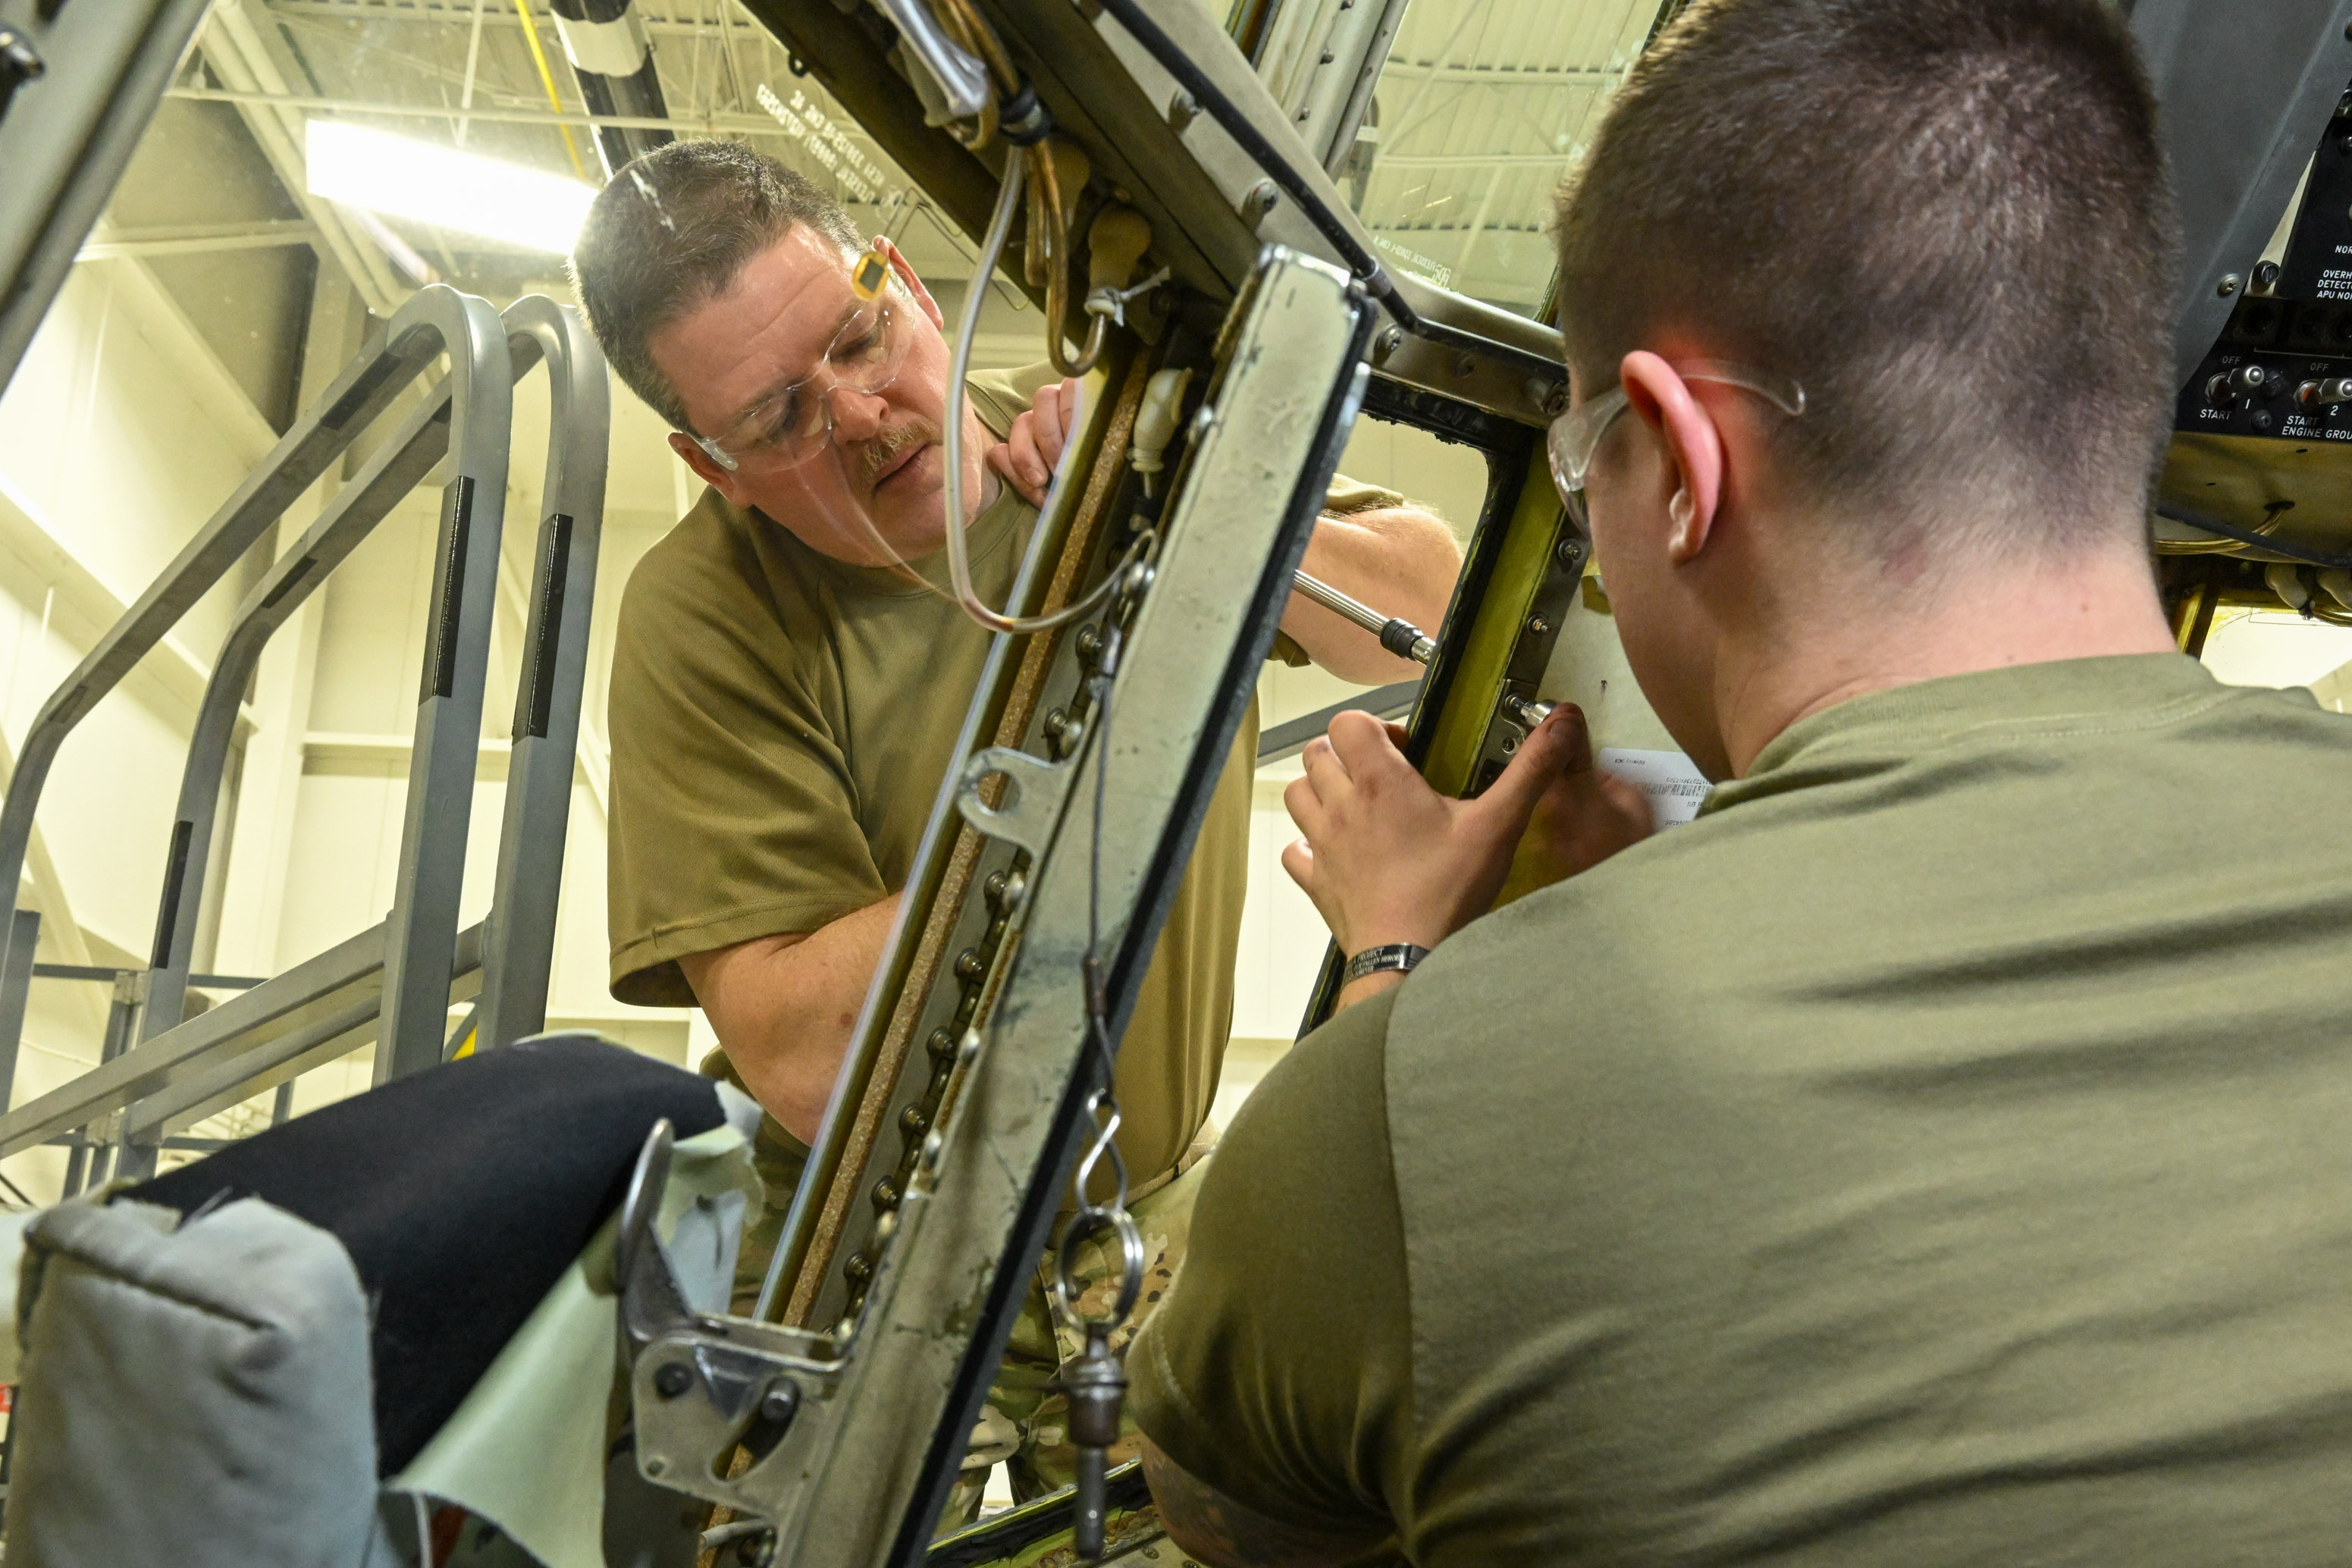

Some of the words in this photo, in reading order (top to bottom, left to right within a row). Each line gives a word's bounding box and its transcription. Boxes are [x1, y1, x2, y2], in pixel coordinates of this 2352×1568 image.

[2317, 279, 2352, 290] DETECT
[2316, 290, 2335, 299] APU
[2222, 356, 2241, 365] OFF
[2310, 362, 2329, 372] OFF
[2200, 409, 2232, 420] START
[2330, 405, 2339, 416] 2
[2286, 416, 2319, 426] START
[2281, 425, 2322, 437] ENGINE
[2325, 429, 2352, 440] GROU
